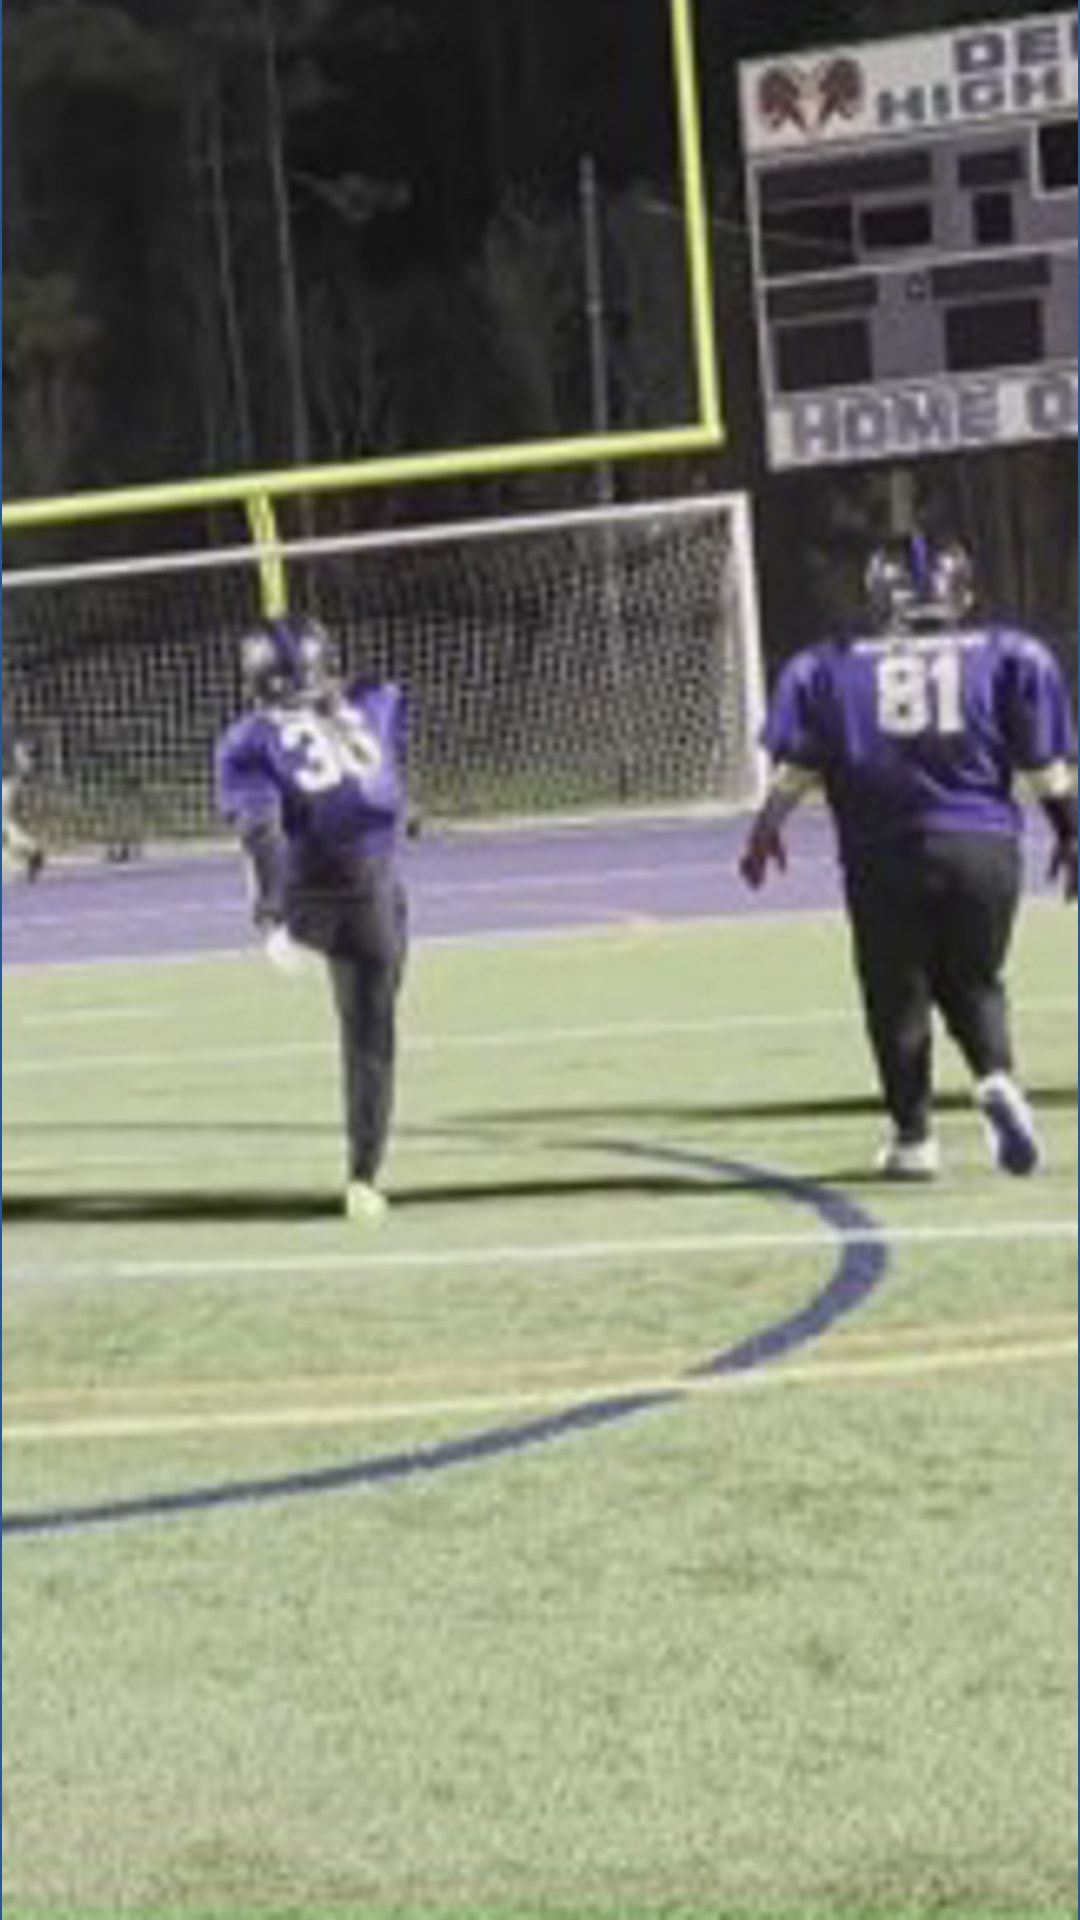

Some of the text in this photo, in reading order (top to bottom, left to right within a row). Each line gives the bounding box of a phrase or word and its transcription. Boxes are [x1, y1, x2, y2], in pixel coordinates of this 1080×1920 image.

[953, 25, 1078, 74] DE
[876, 66, 1065, 127] HIGH
[791, 380, 998, 458] HOME
[876, 653, 965, 736] 81
